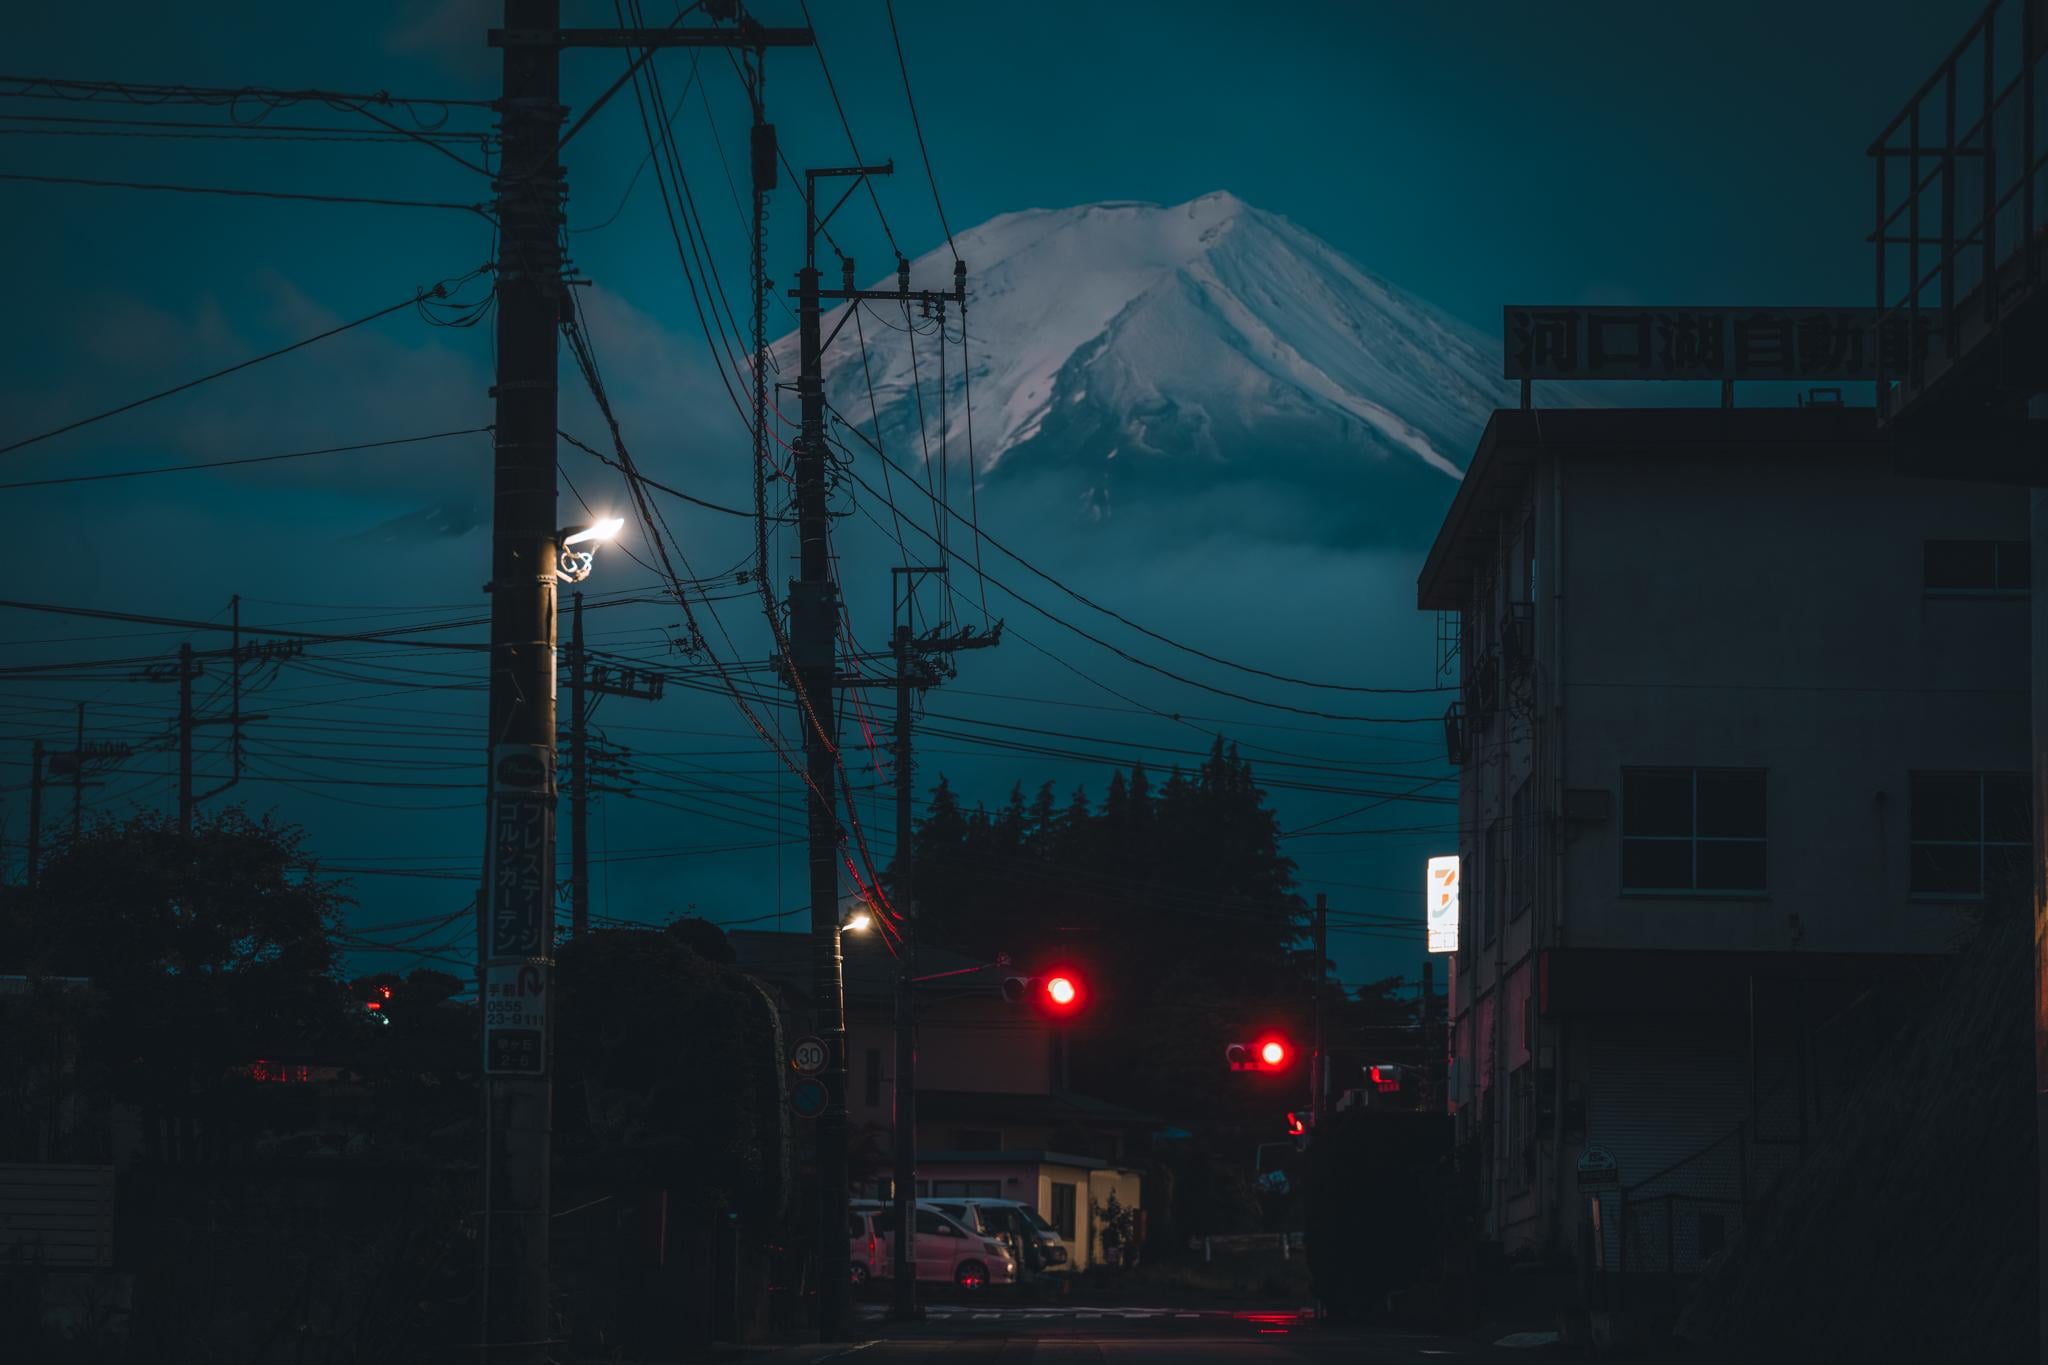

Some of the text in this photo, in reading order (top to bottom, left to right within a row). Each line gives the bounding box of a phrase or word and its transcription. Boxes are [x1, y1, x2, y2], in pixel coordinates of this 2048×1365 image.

[488, 1000, 522, 1012] 0555
[488, 1013, 544, 1026] 23-9111
[800, 1047, 820, 1065] 30
